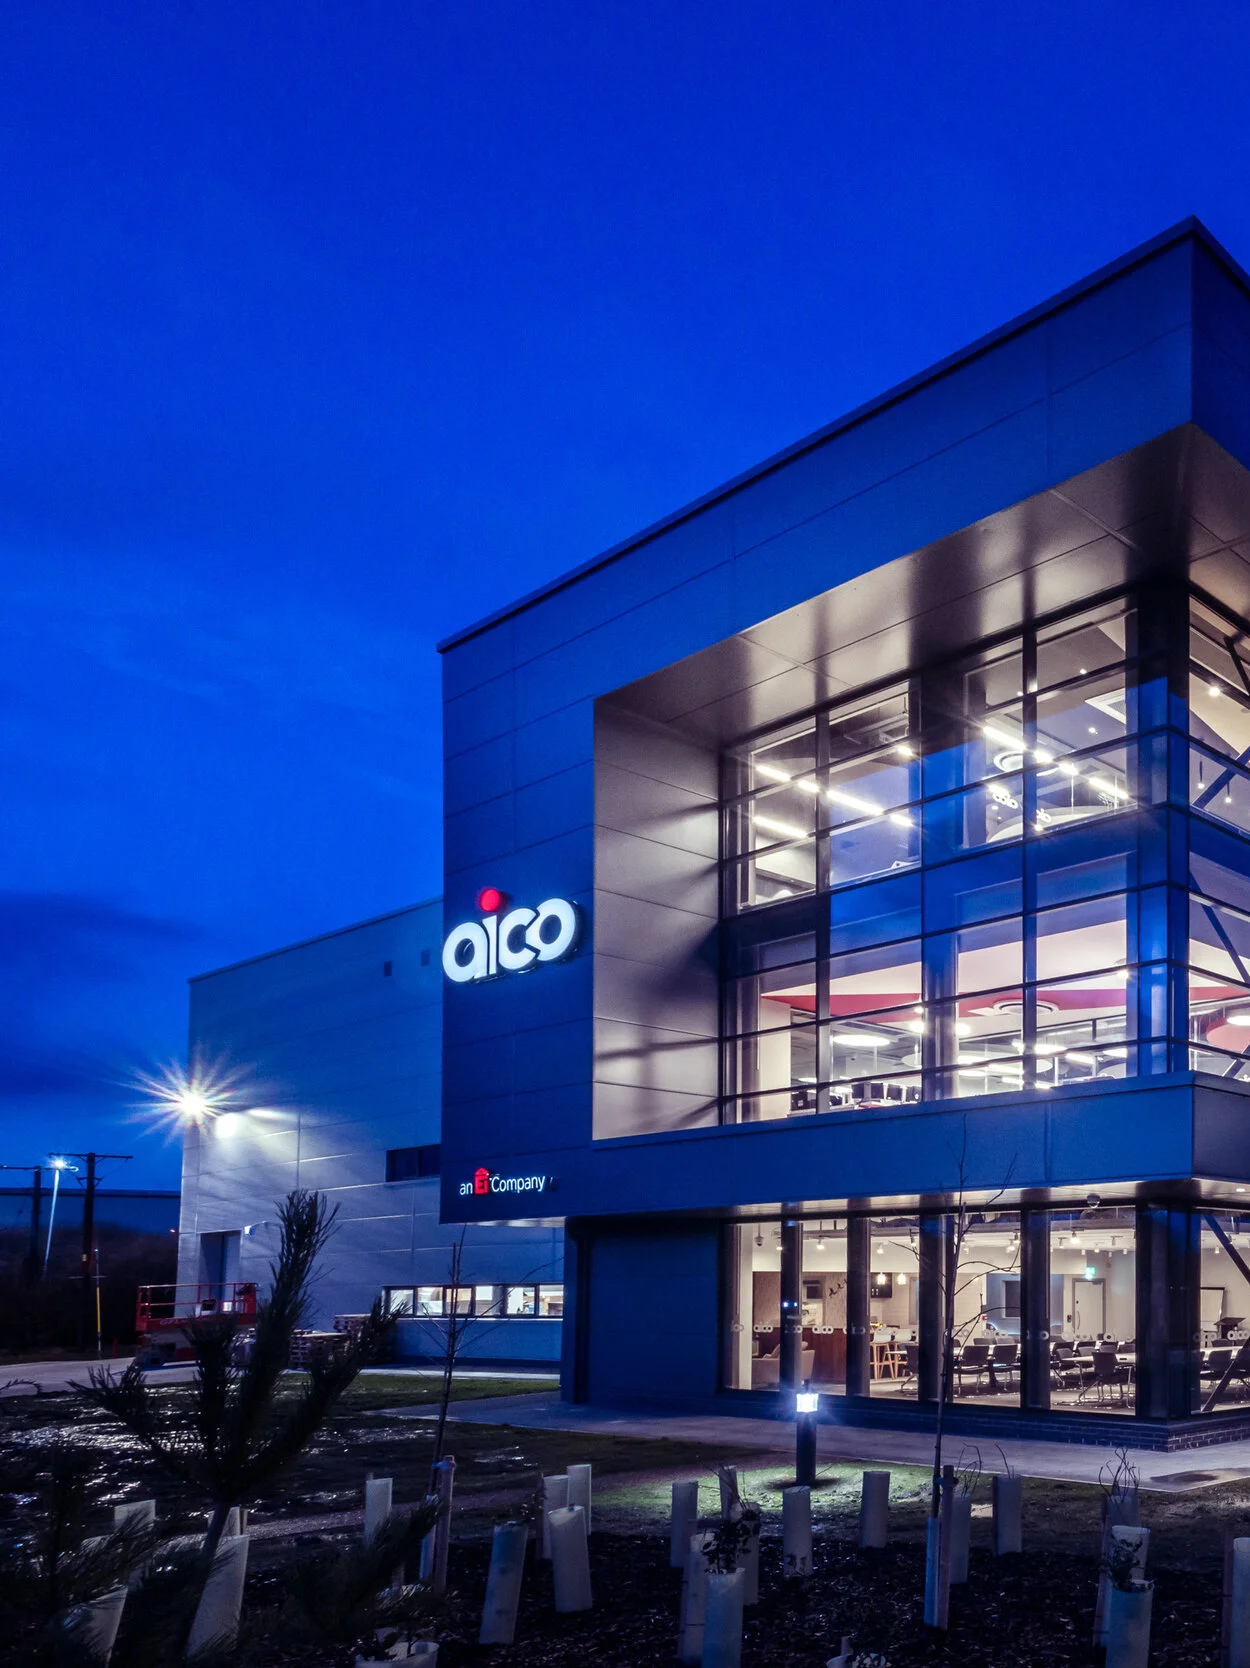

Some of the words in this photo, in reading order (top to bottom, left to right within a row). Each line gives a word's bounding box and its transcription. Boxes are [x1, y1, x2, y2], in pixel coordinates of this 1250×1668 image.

[442, 888, 576, 982] aico
[459, 1182, 473, 1195] an
[491, 1175, 546, 1193] Company
